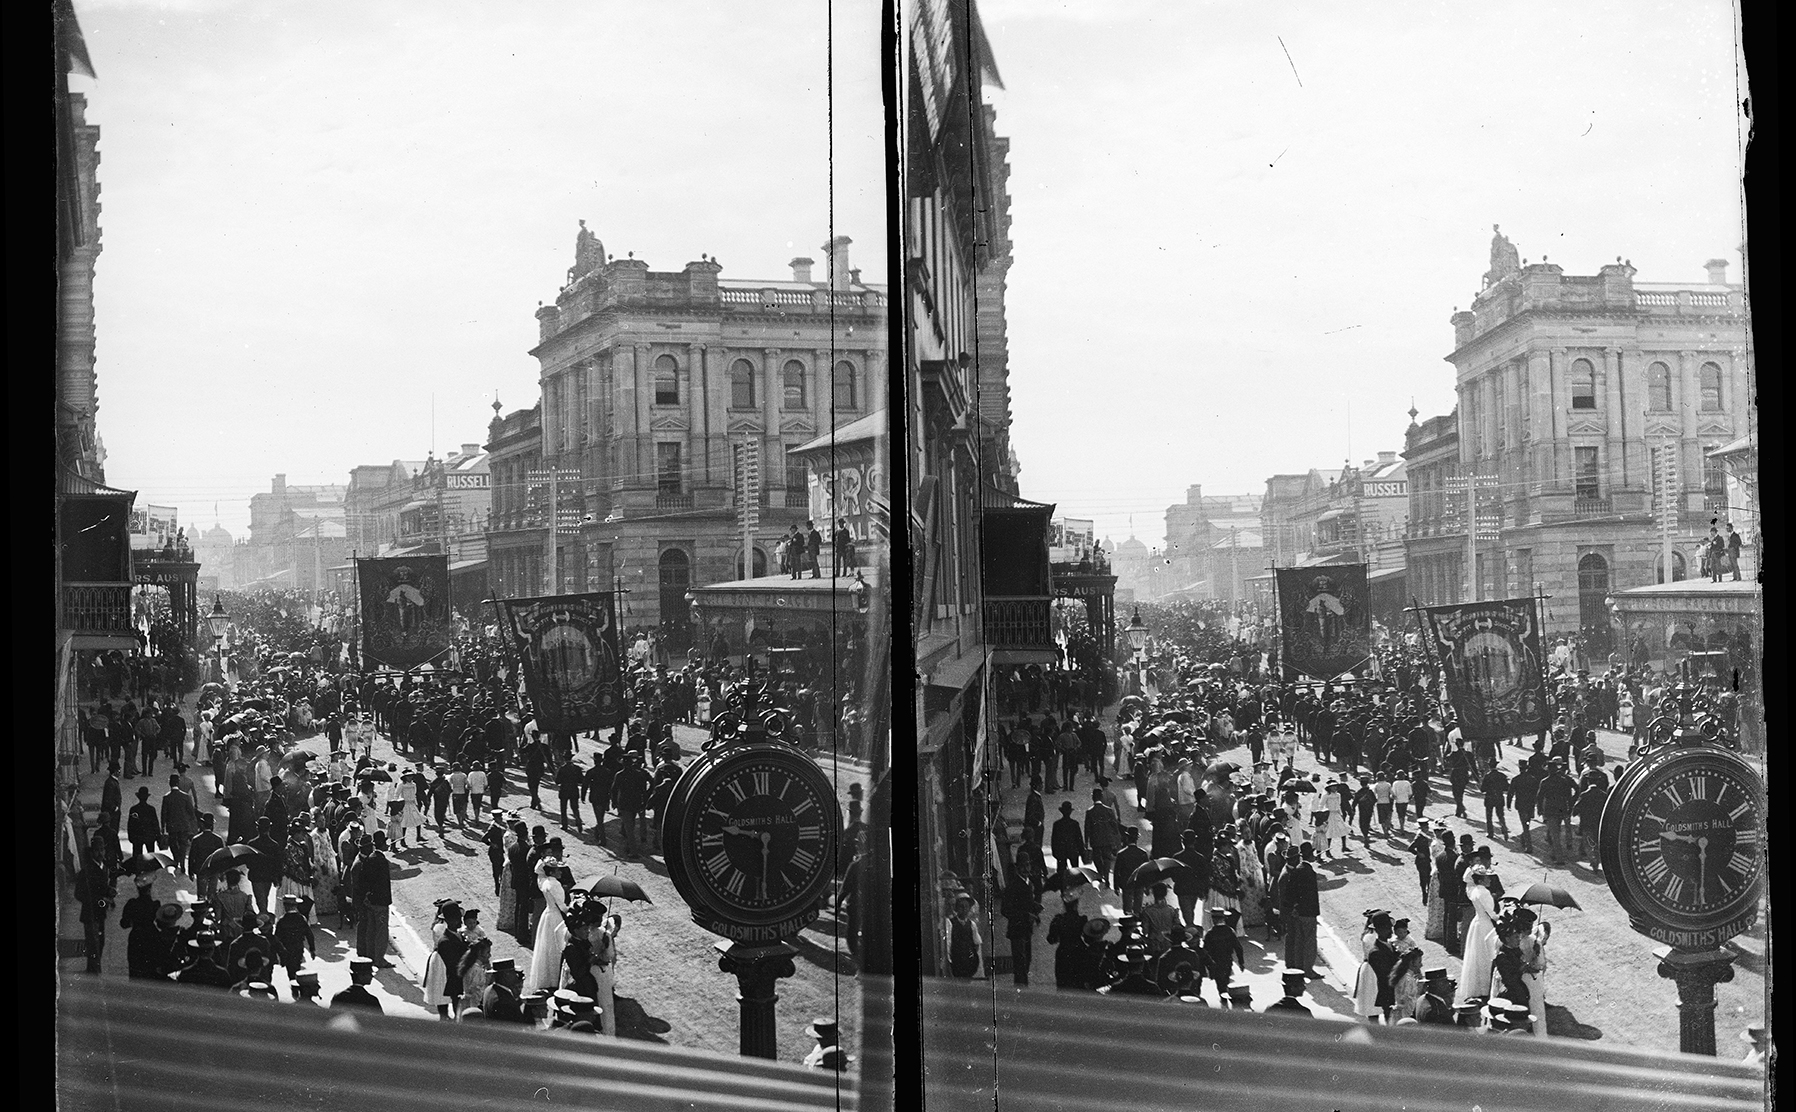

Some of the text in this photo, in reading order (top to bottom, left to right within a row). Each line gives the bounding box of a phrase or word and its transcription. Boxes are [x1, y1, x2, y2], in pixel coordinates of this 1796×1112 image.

[447, 475, 491, 488] RUSSELL
[1363, 482, 1408, 496] RUSSELL
[726, 778, 749, 806] XI
[752, 771, 771, 796] XII
[777, 777, 792, 801] I
[1688, 776, 1707, 800] XII
[1714, 782, 1729, 805] I
[790, 797, 815, 818] II
[1661, 783, 1685, 812] XI
[1727, 801, 1751, 822] II
[798, 824, 820, 841] III
[1735, 829, 1757, 846] III
[706, 850, 732, 880] VIII
[789, 847, 817, 872] IIII
[1643, 855, 1669, 886] VIII
[1726, 851, 1755, 877] IIII
[723, 867, 747, 897] VII
[1662, 872, 1685, 903] VII
[780, 917, 806, 937] HALL
[1718, 920, 1744, 942] HALL
